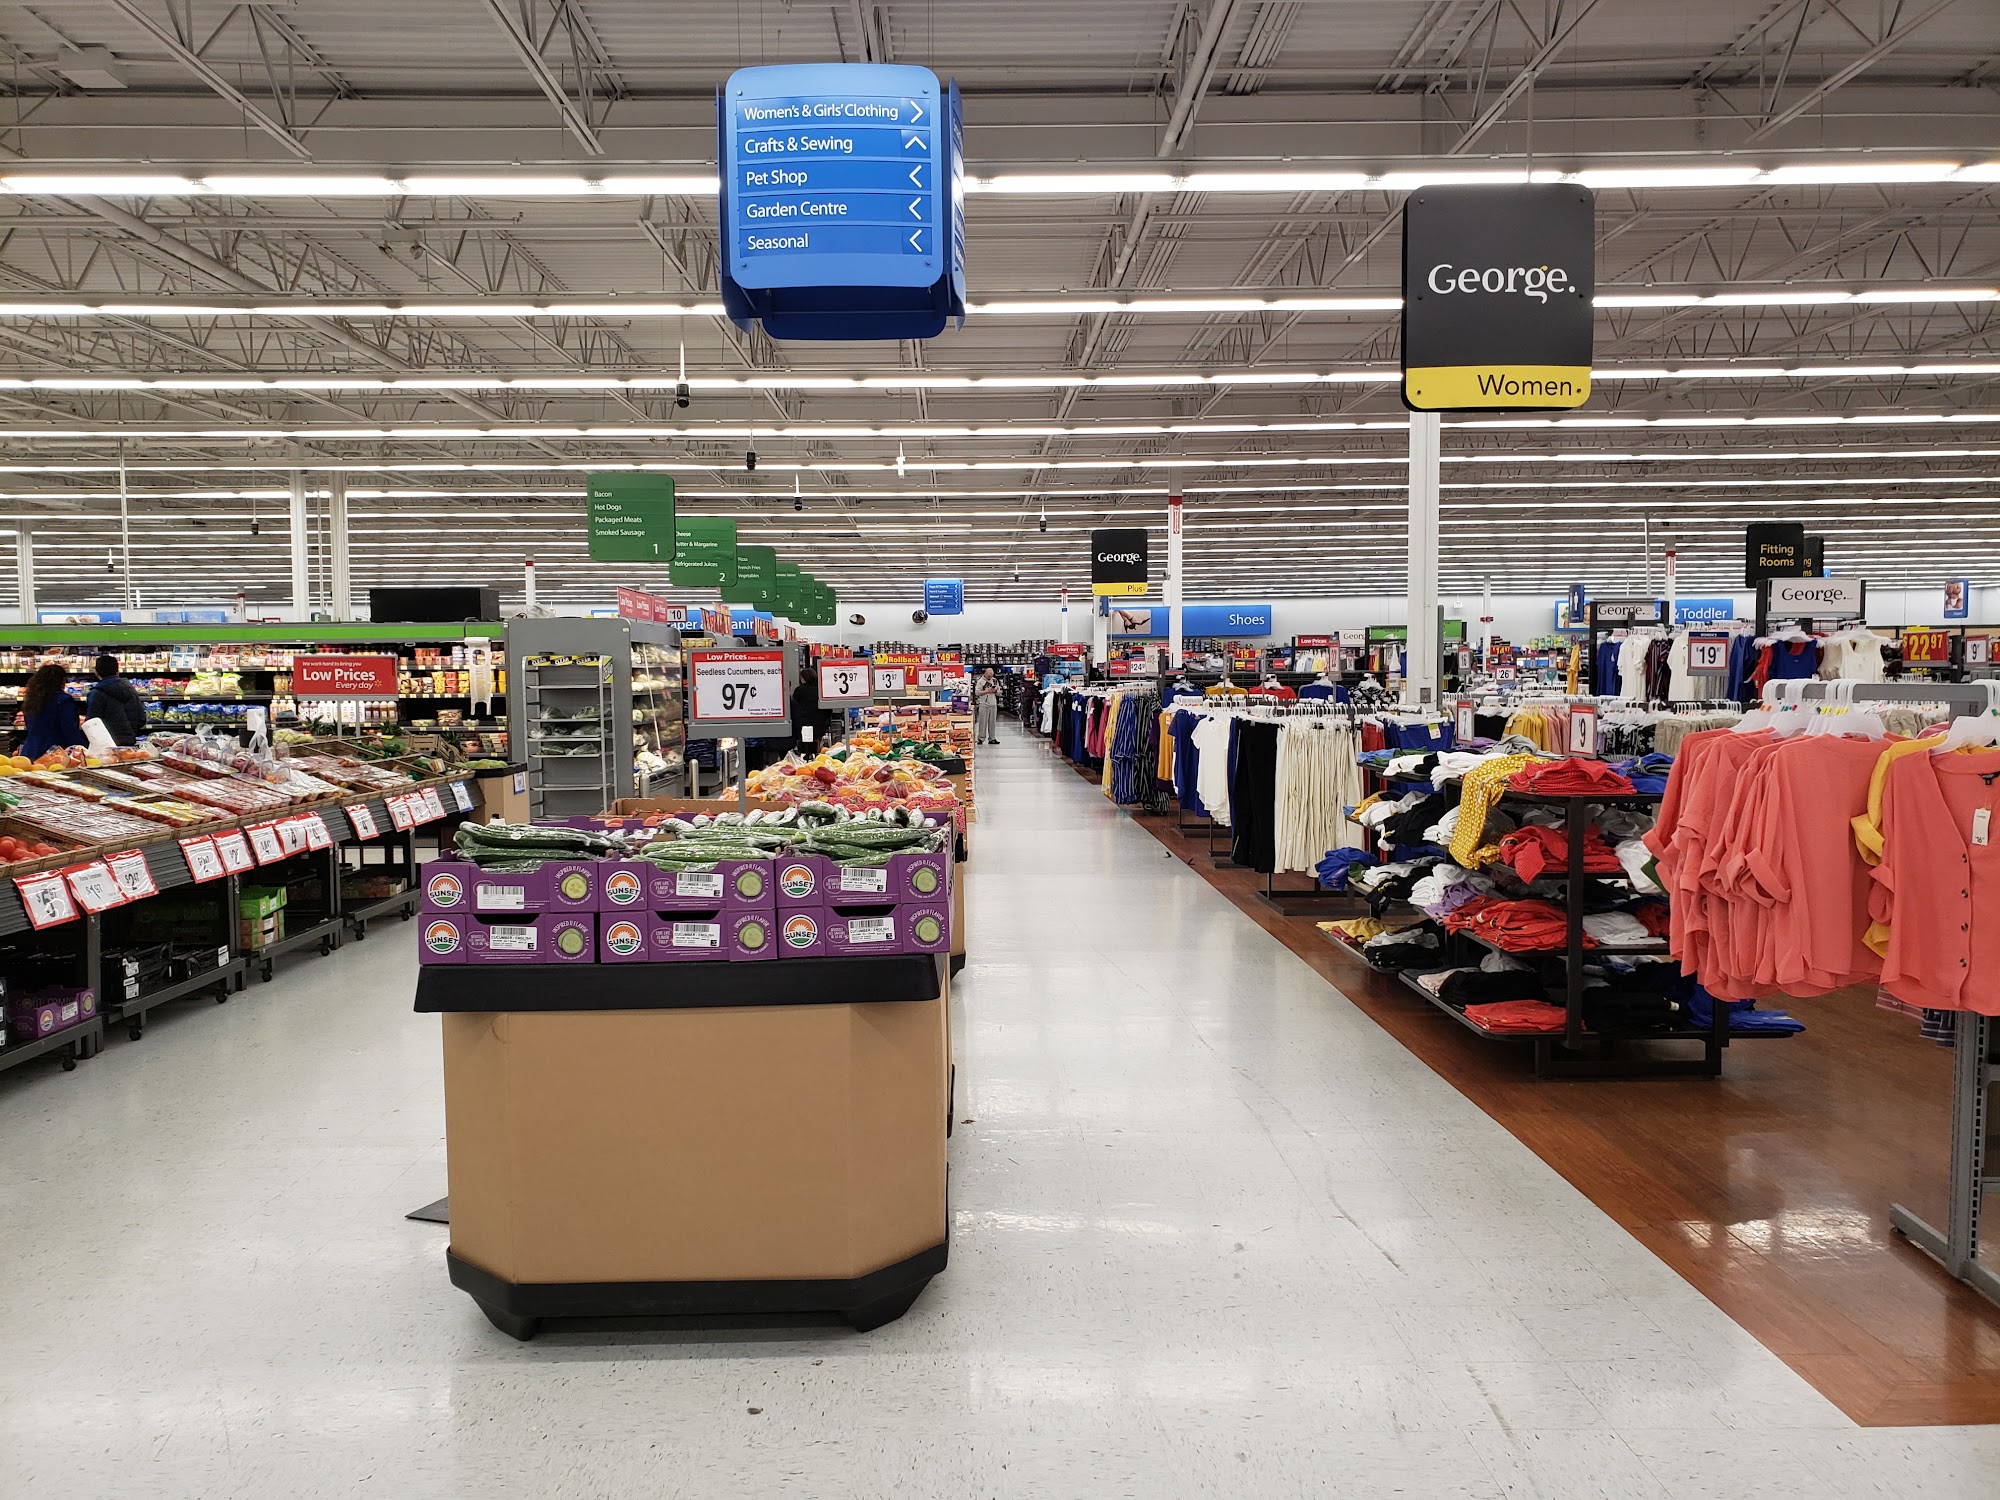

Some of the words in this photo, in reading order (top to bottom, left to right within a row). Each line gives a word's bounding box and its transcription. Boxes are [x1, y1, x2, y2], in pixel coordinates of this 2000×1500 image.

[744, 105, 800, 121] Women's
[801, 105, 812, 117] &
[813, 104, 843, 117] Girls'
[844, 103, 899, 121] Clothing
[744, 136, 784, 153] Crafts
[787, 137, 799, 152] &
[801, 135, 853, 153] Sewing
[746, 170, 769, 186] Pet
[771, 169, 808, 186] Shop
[747, 202, 798, 218] Garden
[800, 201, 848, 216] Centre
[747, 233, 809, 250] Seasonal
[1427, 263, 1576, 305] George.
[1477, 374, 1572, 396] Women
[606, 503, 622, 512] Dogs
[594, 516, 623, 525] Packaged
[620, 529, 646, 538] Sausage
[652, 543, 659, 555] 1
[1760, 543, 1794, 556] Fitting
[1097, 552, 1143, 566] George.
[1759, 557, 1795, 567] Rooms
[719, 572, 726, 582] 2
[1127, 584, 1143, 593] Plus
[761, 590, 768, 599] 3
[1781, 587, 1848, 605] George.
[787, 601, 794, 609] 4
[803, 607, 808, 615] 5
[1681, 607, 1728, 619] Toddler
[1228, 613, 1265, 626] Shoes
[668, 620, 698, 630] aper
[1902, 633, 1943, 661] $2297
[706, 653, 723, 661] Low
[888, 656, 921, 664] Rollback
[302, 668, 332, 681] Low
[334, 668, 376, 681] Prices
[696, 667, 726, 676] Seedless
[727, 667, 766, 676] Cucumbers,
[767, 666, 783, 675] each
[335, 682, 358, 691] Every
[358, 681, 374, 690] day
[833, 672, 858, 695] $397
[721, 683, 757, 711] 97¢
[781, 881, 814, 889] SUNSET
[429, 890, 462, 899] SUNSET
[607, 887, 640, 896] SUNSET
[784, 931, 817, 940] SUNSET
[426, 936, 459, 946] SUNSET
[608, 938, 641, 947] SUNSET
